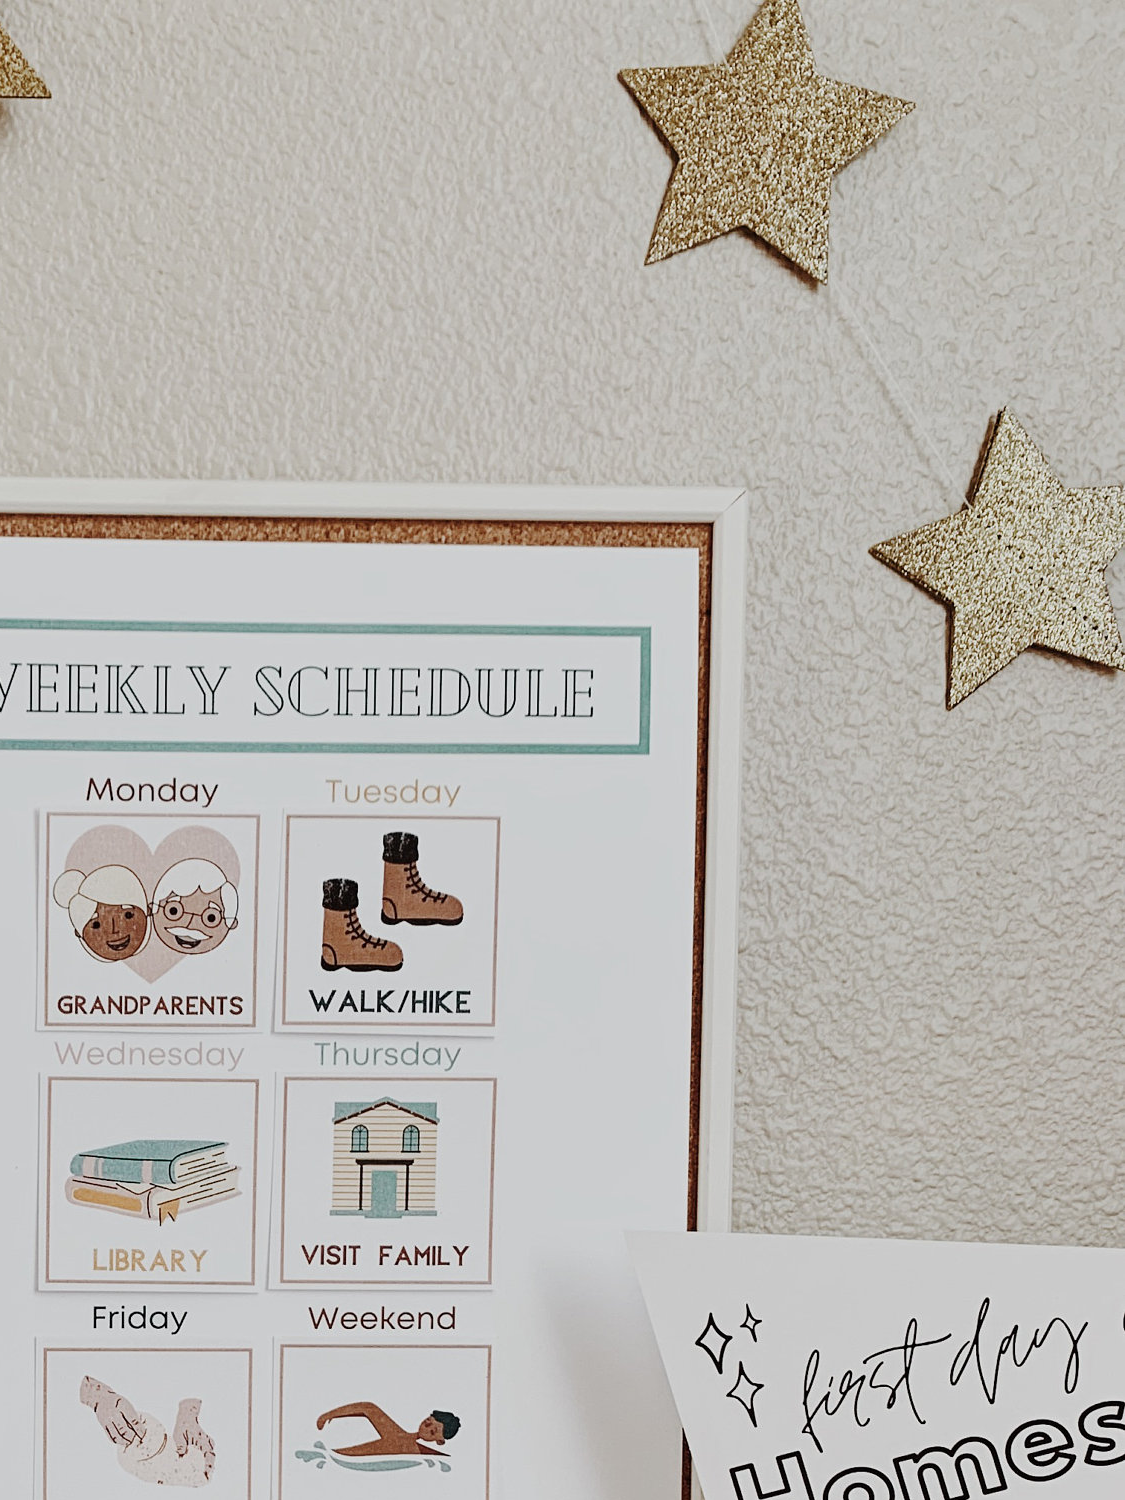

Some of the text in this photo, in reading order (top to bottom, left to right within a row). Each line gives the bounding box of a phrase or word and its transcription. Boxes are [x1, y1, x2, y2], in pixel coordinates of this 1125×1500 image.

[254, 666, 593, 717] SCHEDULE
[87, 778, 218, 807] Monday
[326, 779, 460, 807] Tuesday
[58, 995, 243, 1015] GRANDPARENTS
[309, 990, 470, 1013] WALK/HIKE
[55, 1041, 244, 1071] Wednesday
[315, 1041, 461, 1071] Thursday
[93, 1249, 207, 1272] LIBRARY
[302, 1245, 469, 1266] VISIT FAMILY
[94, 1306, 187, 1335] Friday
[309, 1307, 455, 1330] Weekend
[802, 1297, 1089, 1453] first day
